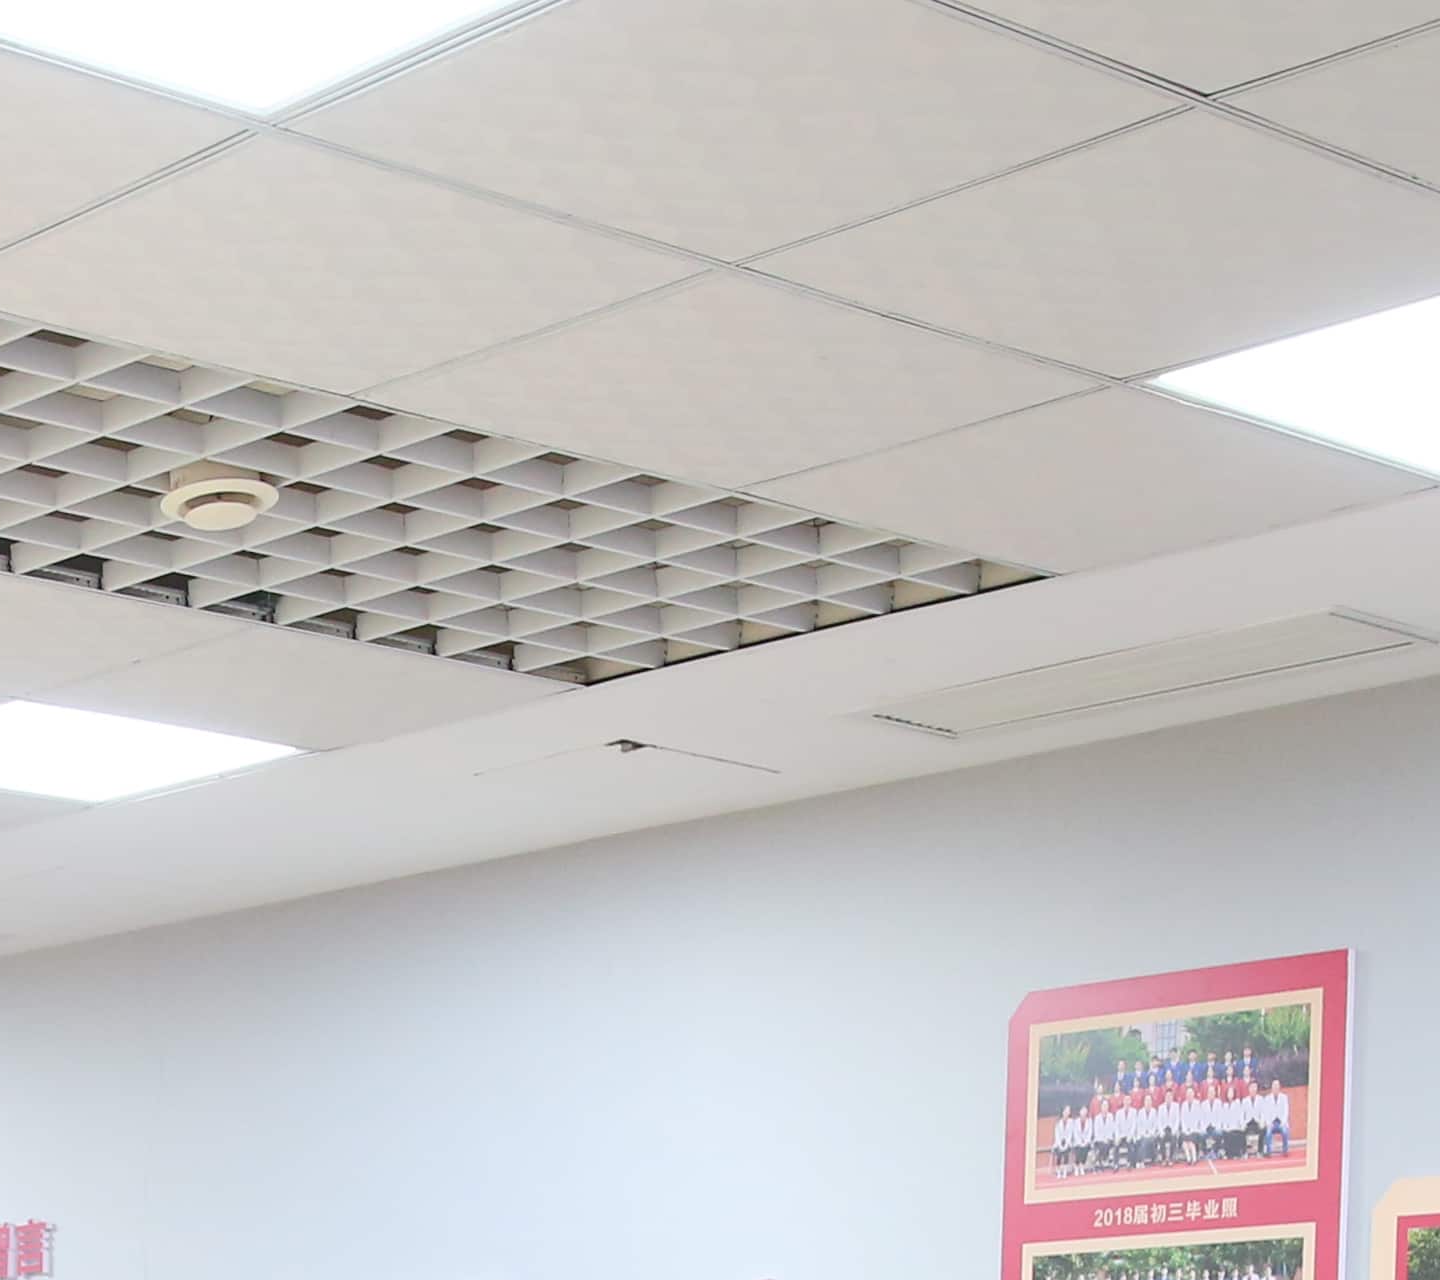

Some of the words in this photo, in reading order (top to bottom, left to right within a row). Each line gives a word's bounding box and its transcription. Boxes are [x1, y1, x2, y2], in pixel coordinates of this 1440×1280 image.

[1093, 1196, 1238, 1228] 2018届初三毕业照
